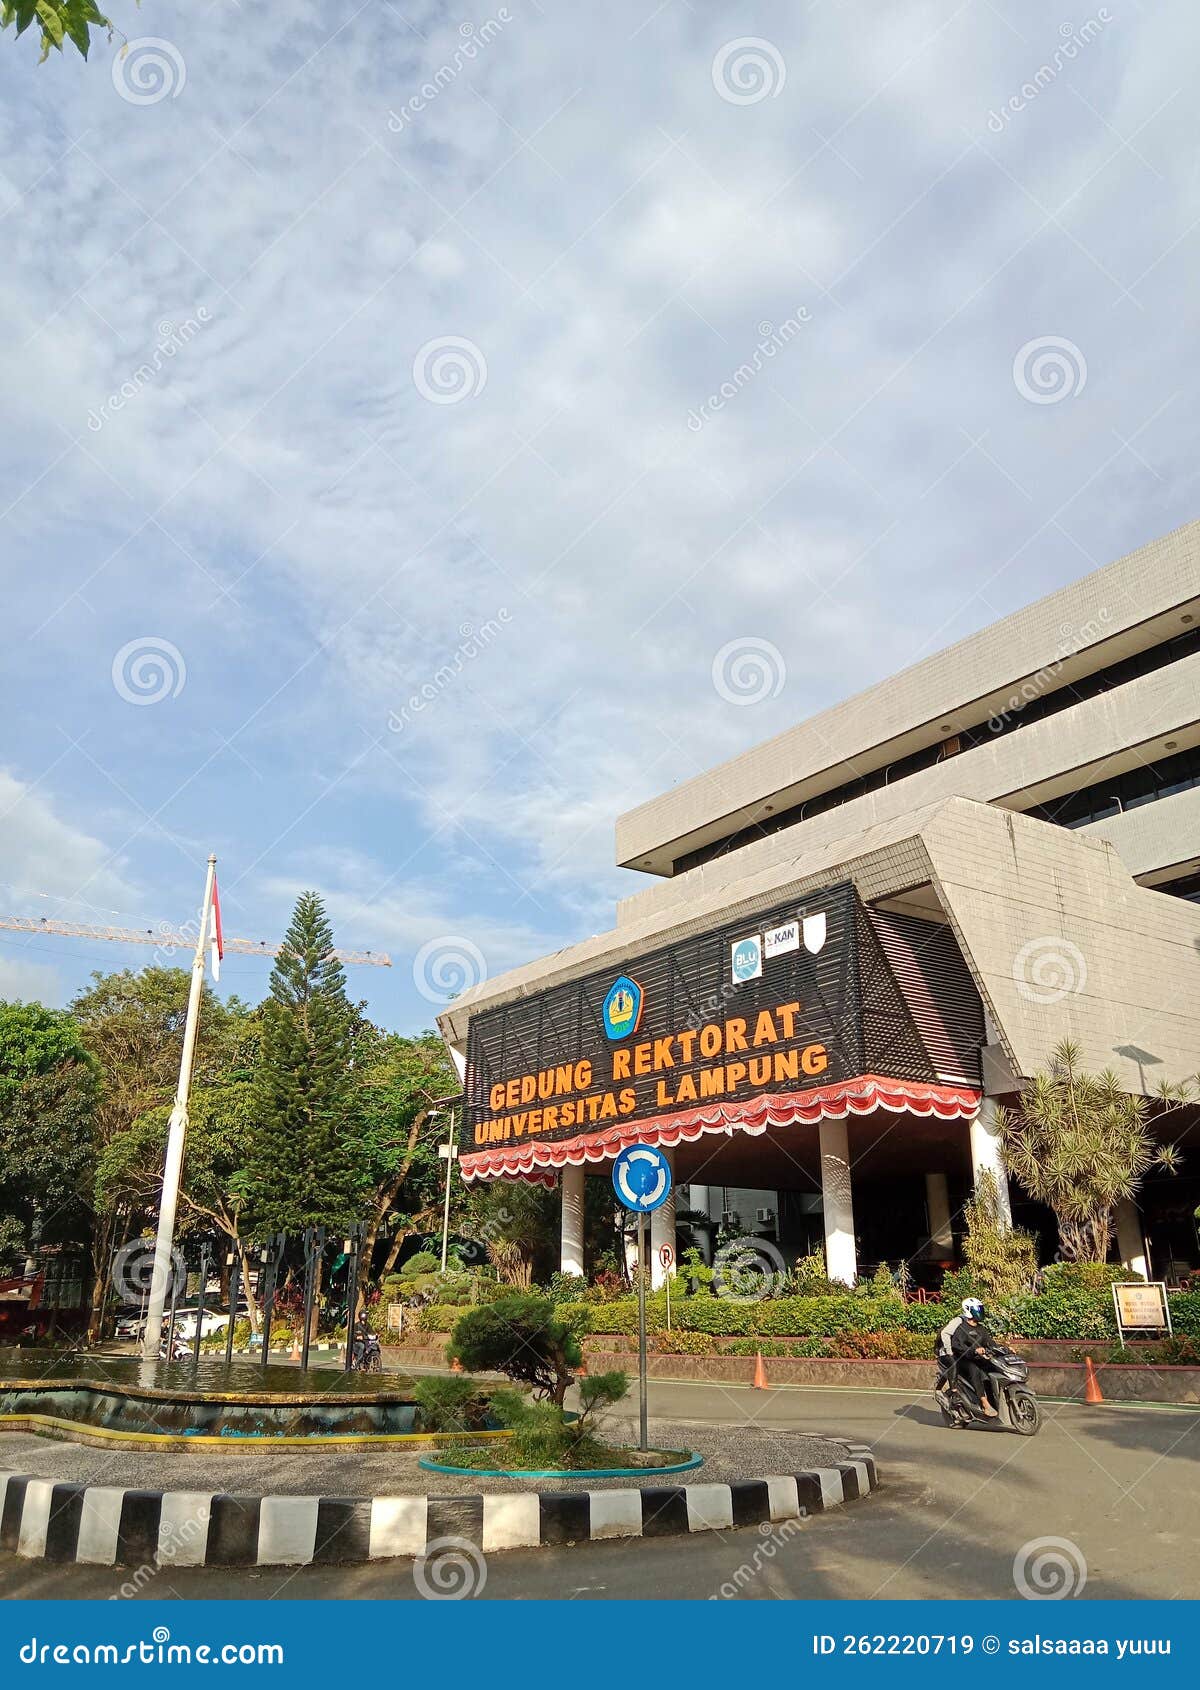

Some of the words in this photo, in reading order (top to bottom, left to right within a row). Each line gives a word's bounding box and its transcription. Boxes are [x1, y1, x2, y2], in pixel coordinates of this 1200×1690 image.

[736, 952, 756, 966] BLU
[774, 928, 795, 945] KAN
[489, 1060, 592, 1111] GEDUNG
[613, 1002, 800, 1081] REKTORAT
[474, 1088, 636, 1145] UNIVERSITAS
[656, 1044, 828, 1107] LAMPUNG
